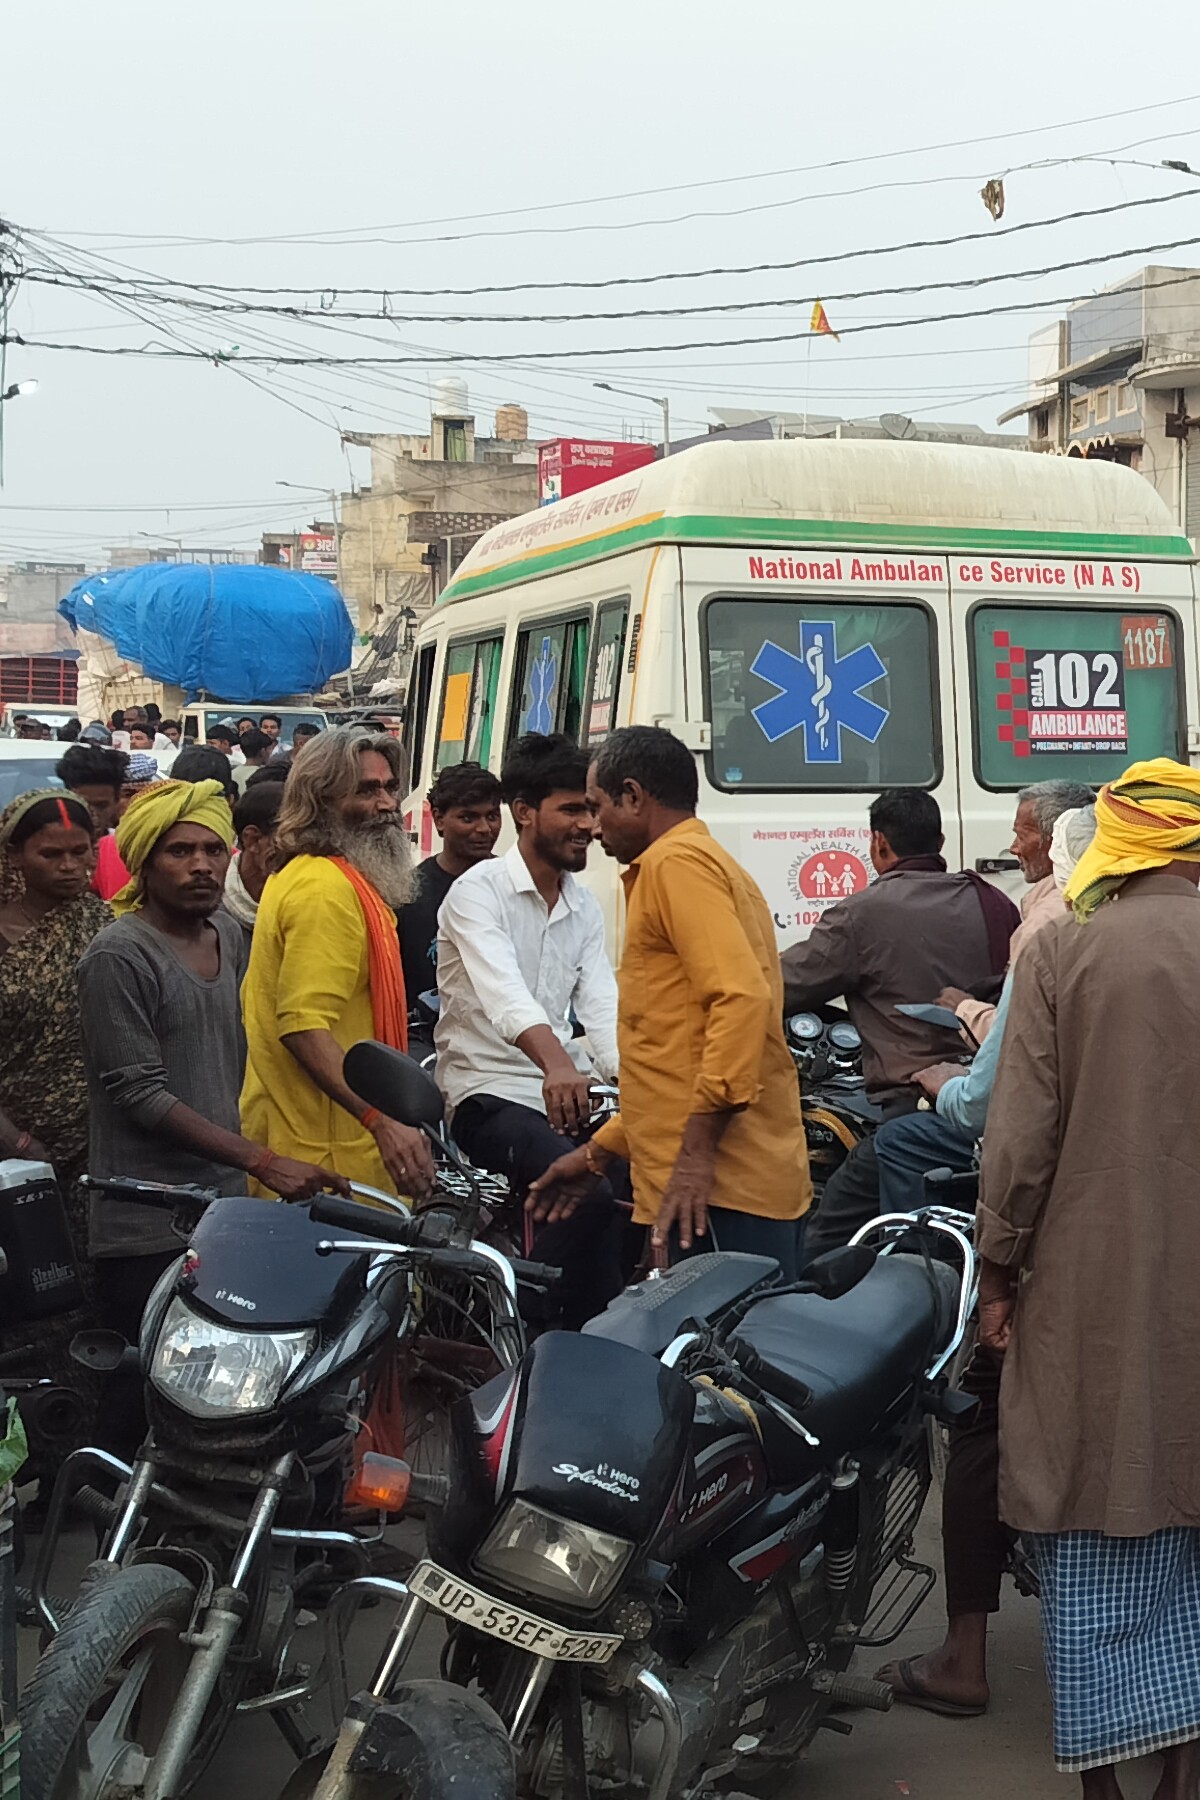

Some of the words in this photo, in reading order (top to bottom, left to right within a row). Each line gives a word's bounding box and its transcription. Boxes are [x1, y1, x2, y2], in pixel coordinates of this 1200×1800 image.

[749, 556, 843, 580] National
[850, 558, 944, 582] Ambulan
[990, 560, 1066, 585] Service
[1101, 565, 1115, 587] A
[1124, 627, 1166, 665] 1187
[1030, 672, 1044, 708] CALL
[1033, 652, 1121, 708] 102
[1031, 713, 1126, 736] AMBULANCE
[753, 829, 787, 840] नेशनल
[828, 827, 855, 839] सर्विस
[787, 851, 811, 901] NATIONAL
[810, 841, 860, 855] HEALTH
[794, 911, 820, 926] 102
[227, 1293, 256, 1311] Hero
[609, 1468, 640, 1490] Hero
[698, 1472, 728, 1509] Hero
[438, 1584, 476, 1613] UP
[482, 1606, 554, 1647] 53EF
[556, 1637, 615, 1659] 5281
